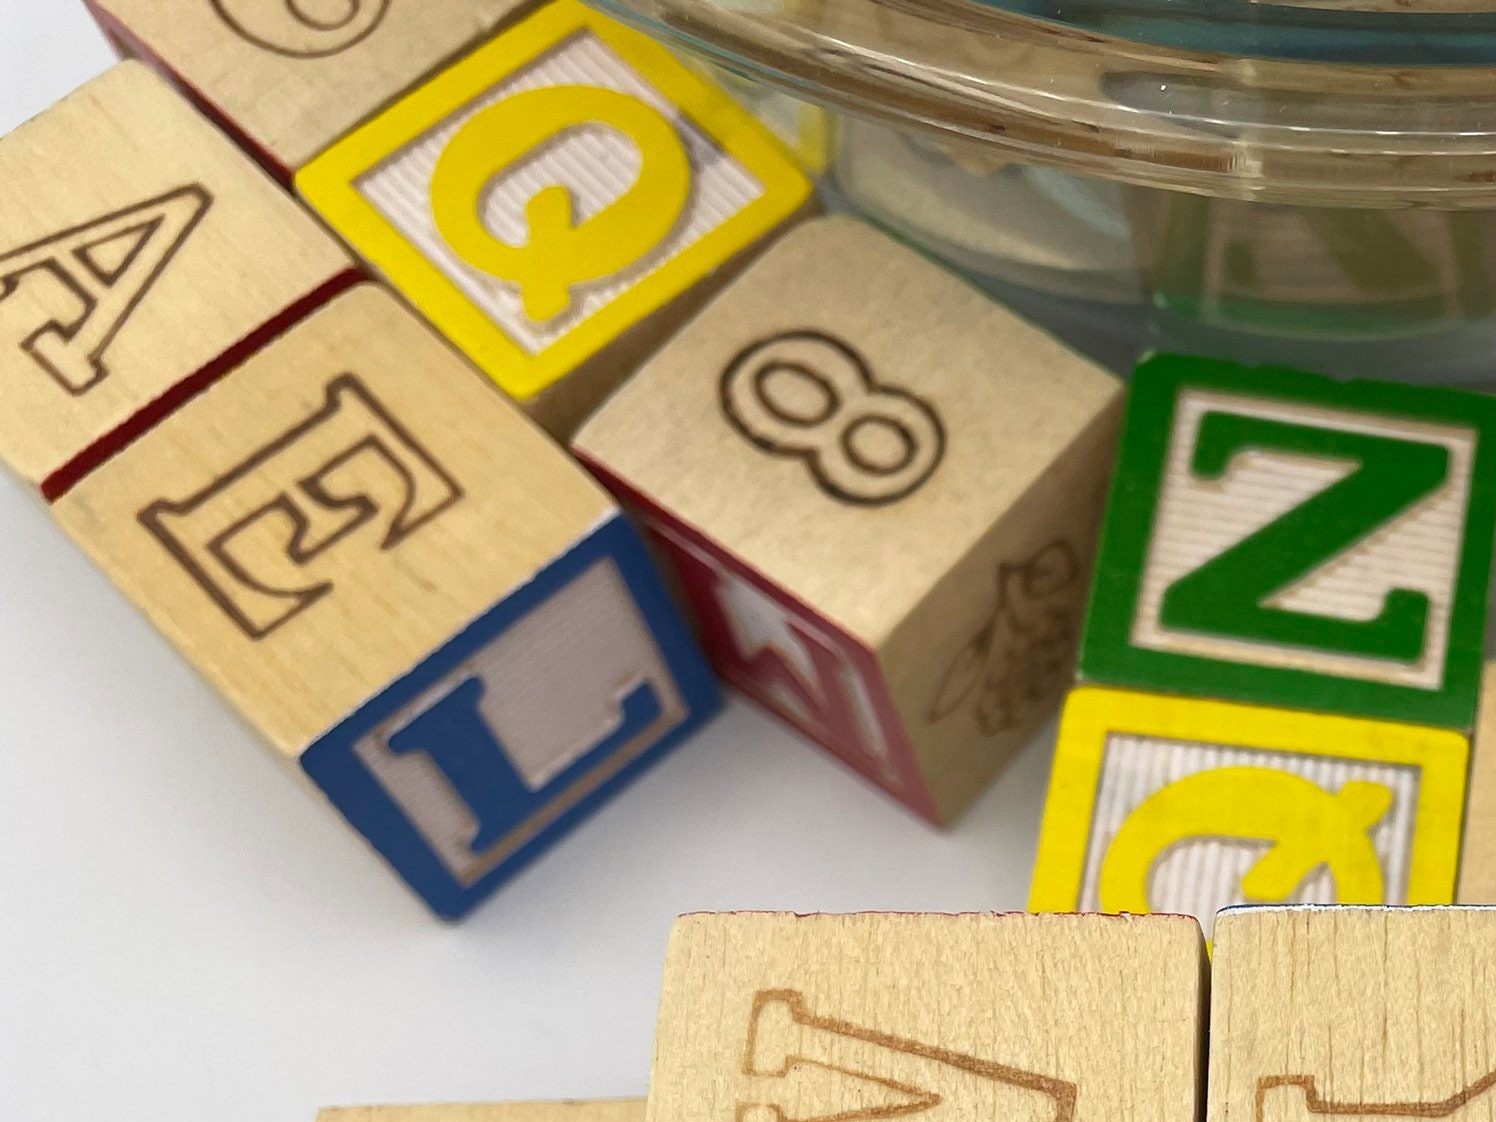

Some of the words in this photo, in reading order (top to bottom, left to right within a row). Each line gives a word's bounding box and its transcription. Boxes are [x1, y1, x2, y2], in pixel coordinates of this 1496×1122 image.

[0, 181, 214, 397] A
[431, 84, 692, 322] Q
[137, 373, 466, 640] E
[717, 328, 947, 508] 8
[1159, 410, 1451, 664] Z
[388, 677, 664, 852] L
